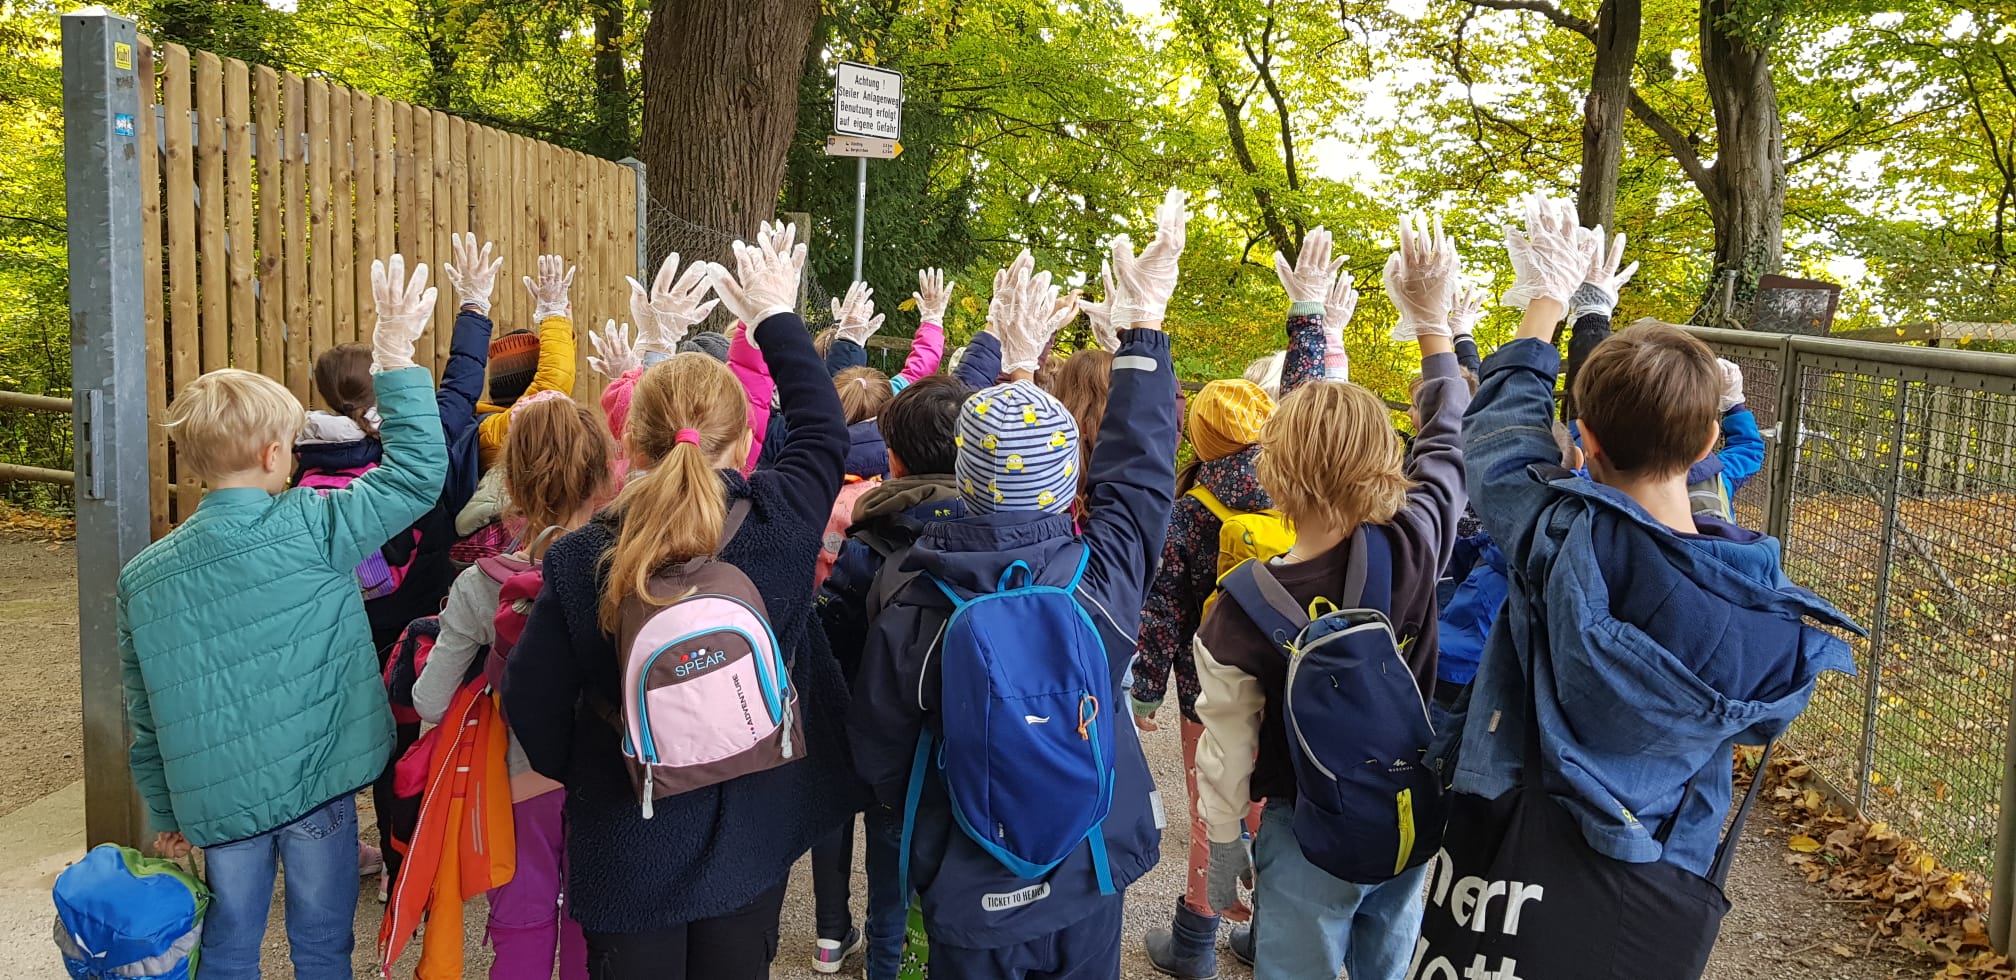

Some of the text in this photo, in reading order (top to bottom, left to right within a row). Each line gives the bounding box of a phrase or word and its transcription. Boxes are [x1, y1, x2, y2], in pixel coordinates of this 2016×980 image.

[855, 75, 886, 91] Achtung !
[839, 86, 899, 108] Steiler Anlagenweg
[840, 101, 896, 121] Benutzung erfolgt
[839, 115, 897, 134] auf eigene Gefahr
[675, 650, 727, 677] SPEAR
[732, 673, 754, 725] ADVENTURE
[987, 896, 1010, 908] TICKET
[1013, 893, 1021, 903] TO
